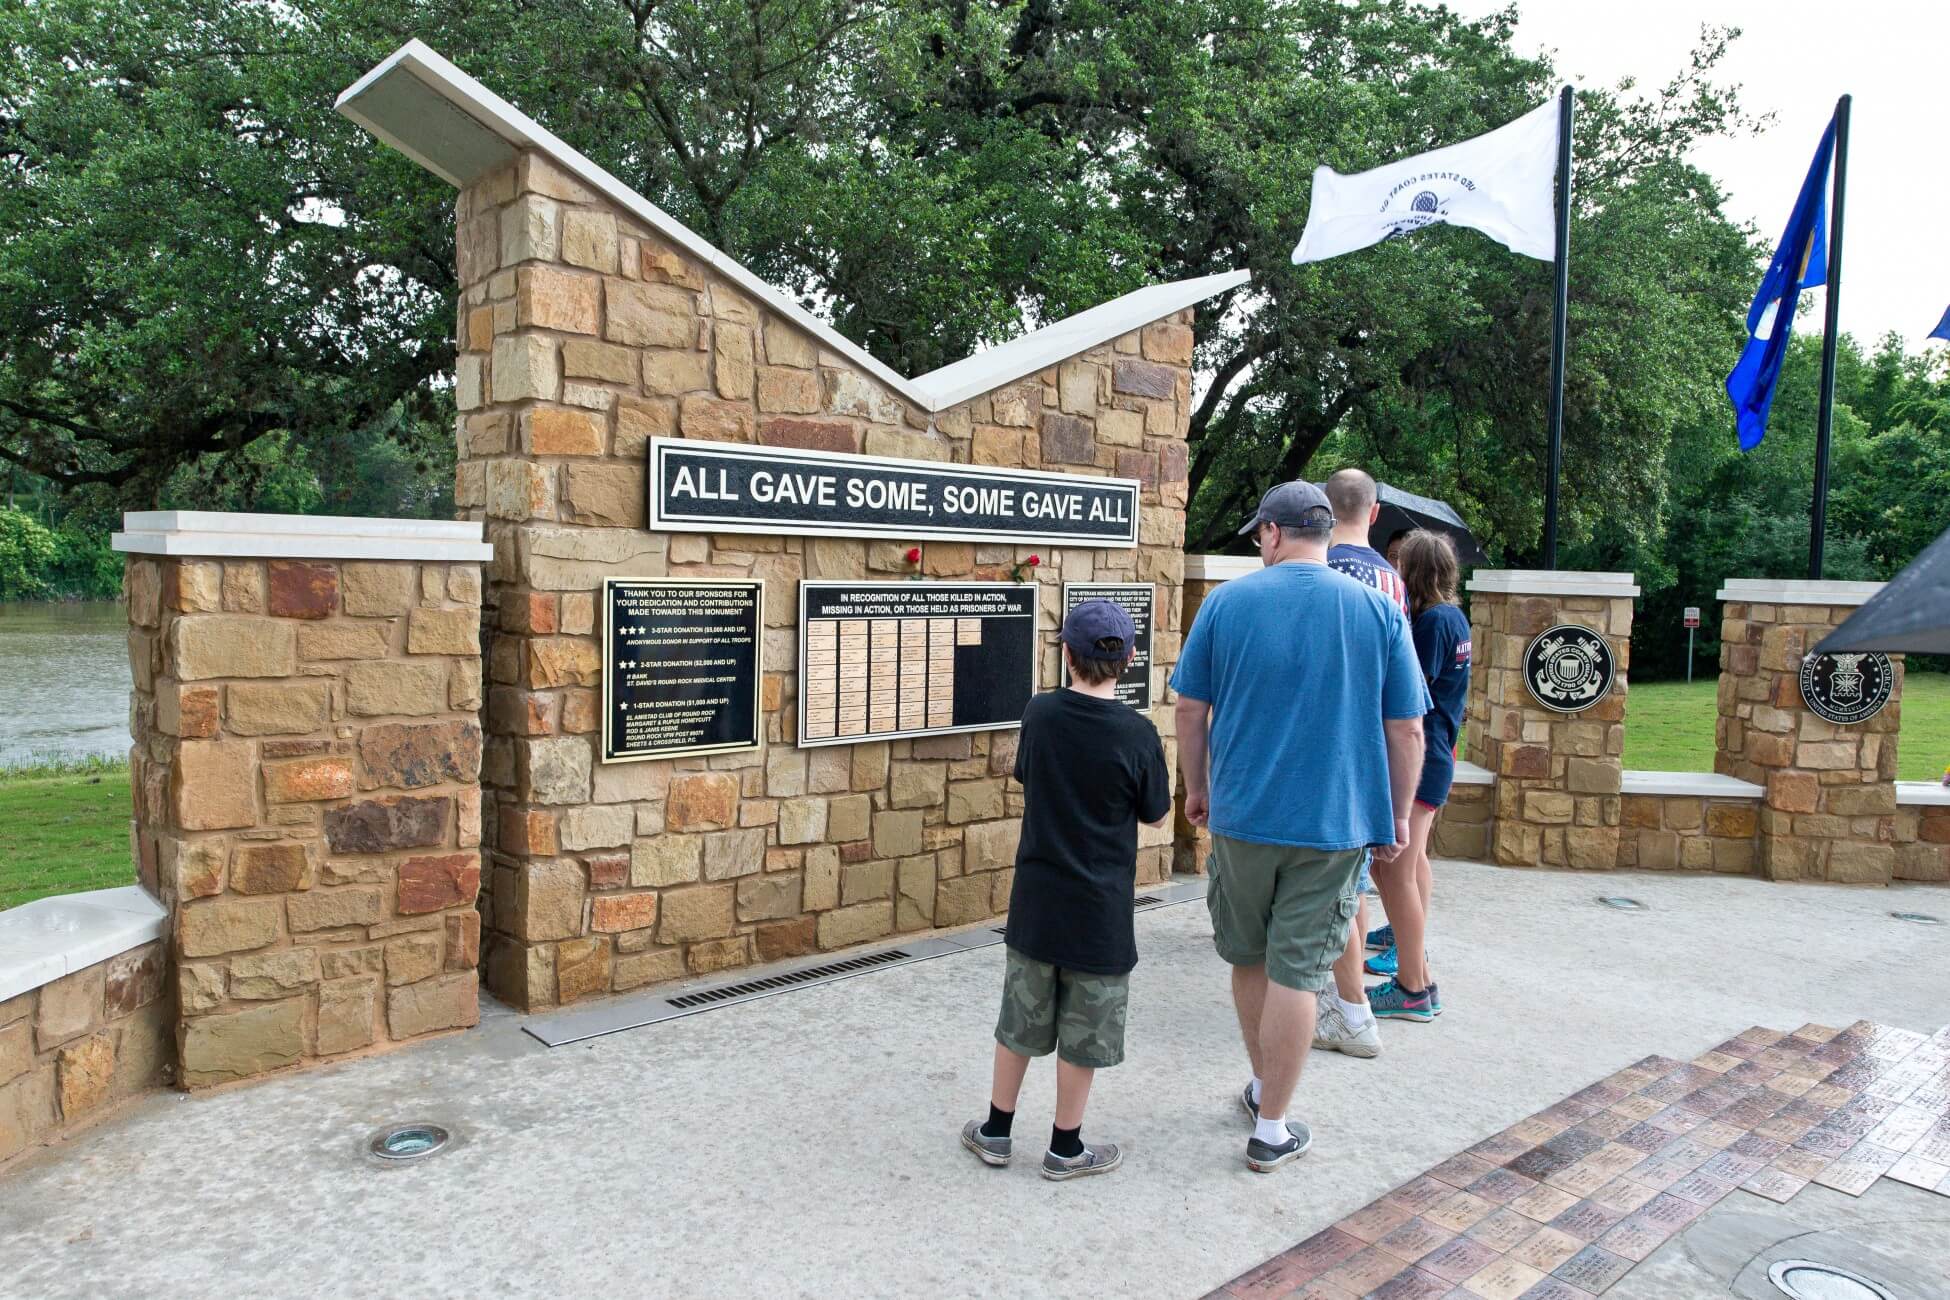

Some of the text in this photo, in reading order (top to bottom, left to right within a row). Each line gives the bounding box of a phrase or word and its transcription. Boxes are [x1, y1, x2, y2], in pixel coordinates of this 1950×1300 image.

[671, 466, 1129, 523] ALL GAVE SOME, SOME GAVE ALL
[840, 593, 1007, 603] IN RECOGNITION OF ALL THOSE KILLED IN ACTION,
[822, 604, 1022, 615] MISSING IN ACTION, OR THOSE HELD AS PRISONERS OF WAR
[1550, 648, 1570, 663] STATES
[1571, 648, 1589, 663] COAST
[1882, 664, 1891, 693] FORCE
[1809, 699, 1827, 716] UNITED
[1860, 700, 1882, 718] AMERICA
